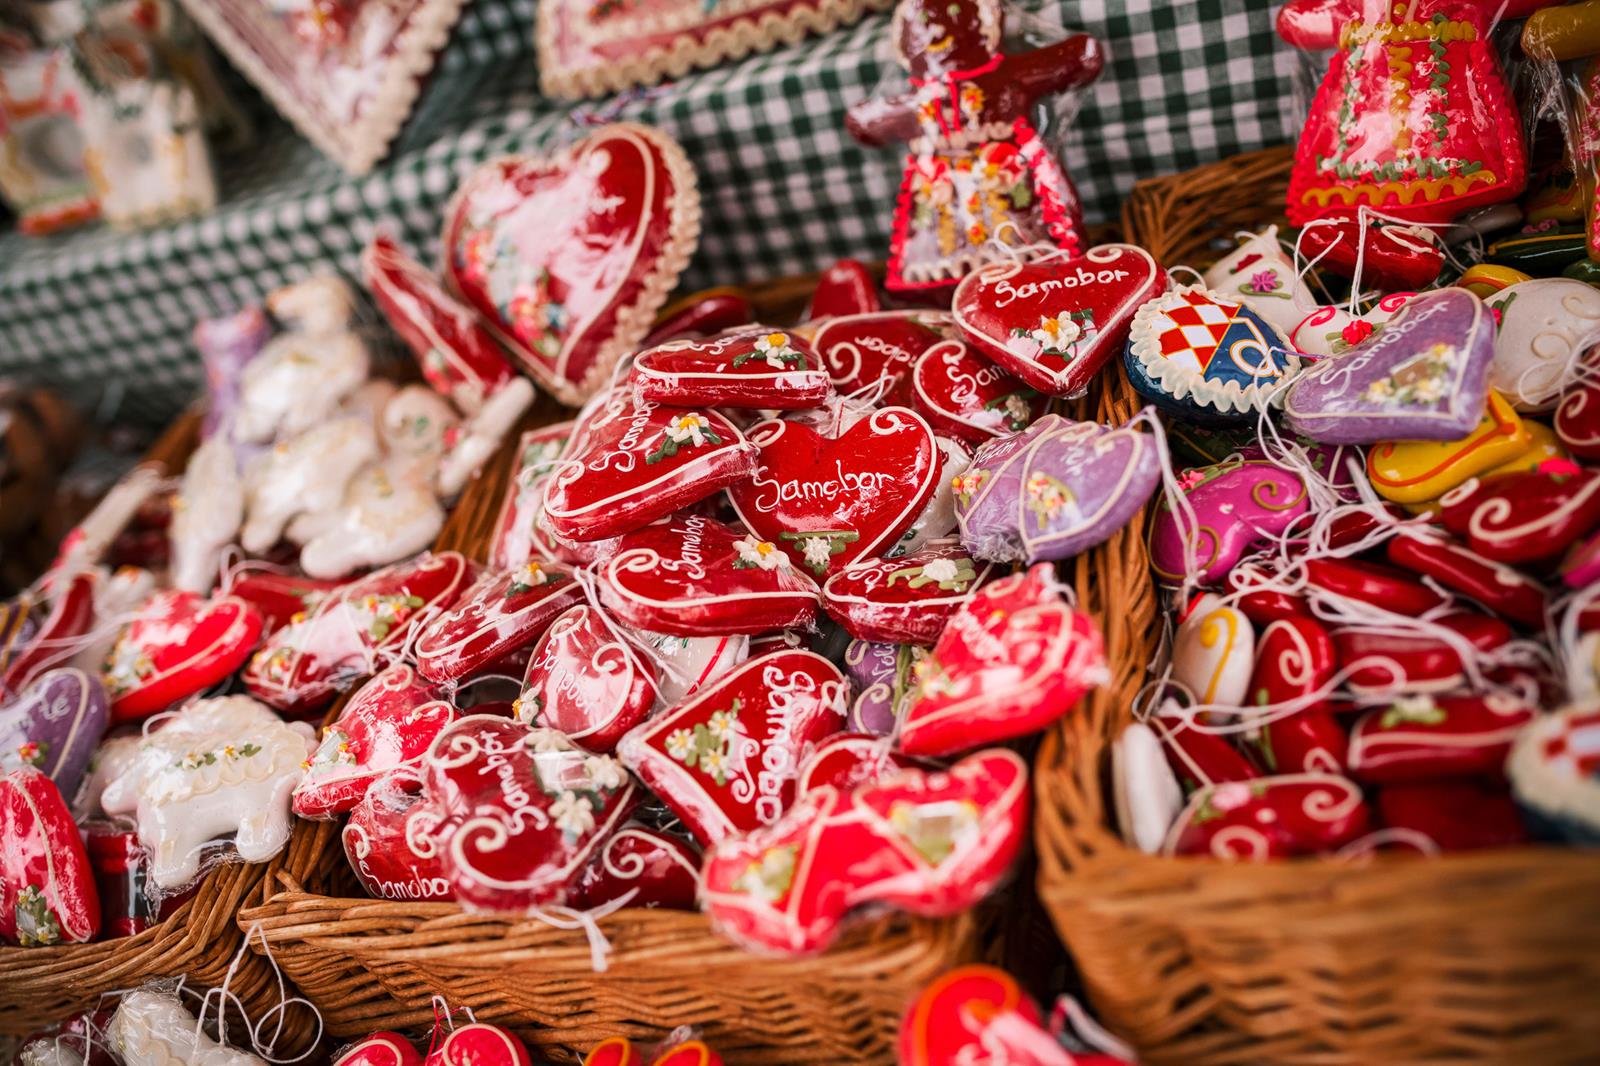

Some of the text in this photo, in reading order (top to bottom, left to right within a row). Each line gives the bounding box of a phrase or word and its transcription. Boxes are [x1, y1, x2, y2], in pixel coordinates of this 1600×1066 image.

[994, 266, 1130, 309] Samobor
[1320, 300, 1449, 401] Samobor
[588, 401, 661, 472] Samobo
[752, 459, 896, 513] Samobor
[660, 513, 706, 580] Samobor
[755, 665, 816, 826] Samobo
[474, 730, 550, 836] Samobor
[358, 859, 450, 899] Samobo
